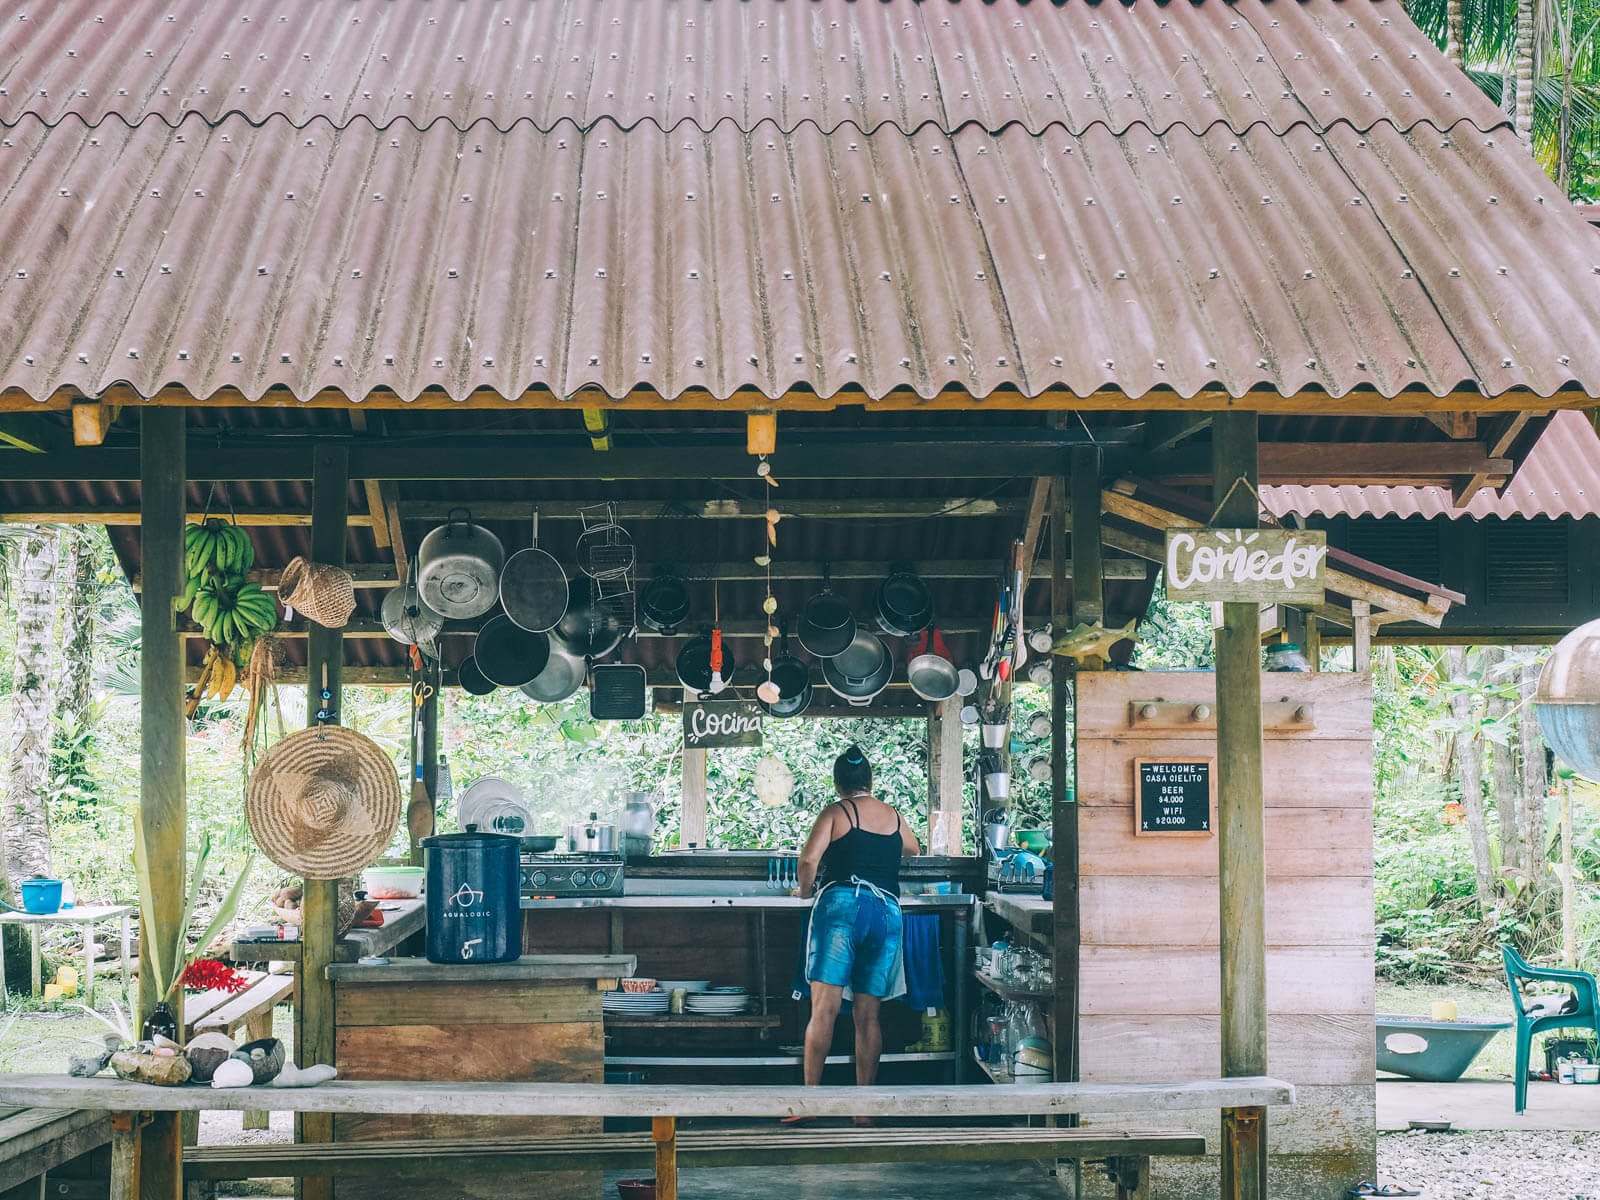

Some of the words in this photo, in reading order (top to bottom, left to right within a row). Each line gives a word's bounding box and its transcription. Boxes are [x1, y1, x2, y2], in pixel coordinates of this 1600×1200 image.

[1167, 533, 1327, 590] Comedor
[692, 708, 763, 737] Cocina
[1145, 774, 1167, 782] CASA
[1169, 774, 1202, 782] CIELITO
[1161, 786, 1184, 794] BEER
[1163, 807, 1182, 815] WIFI
